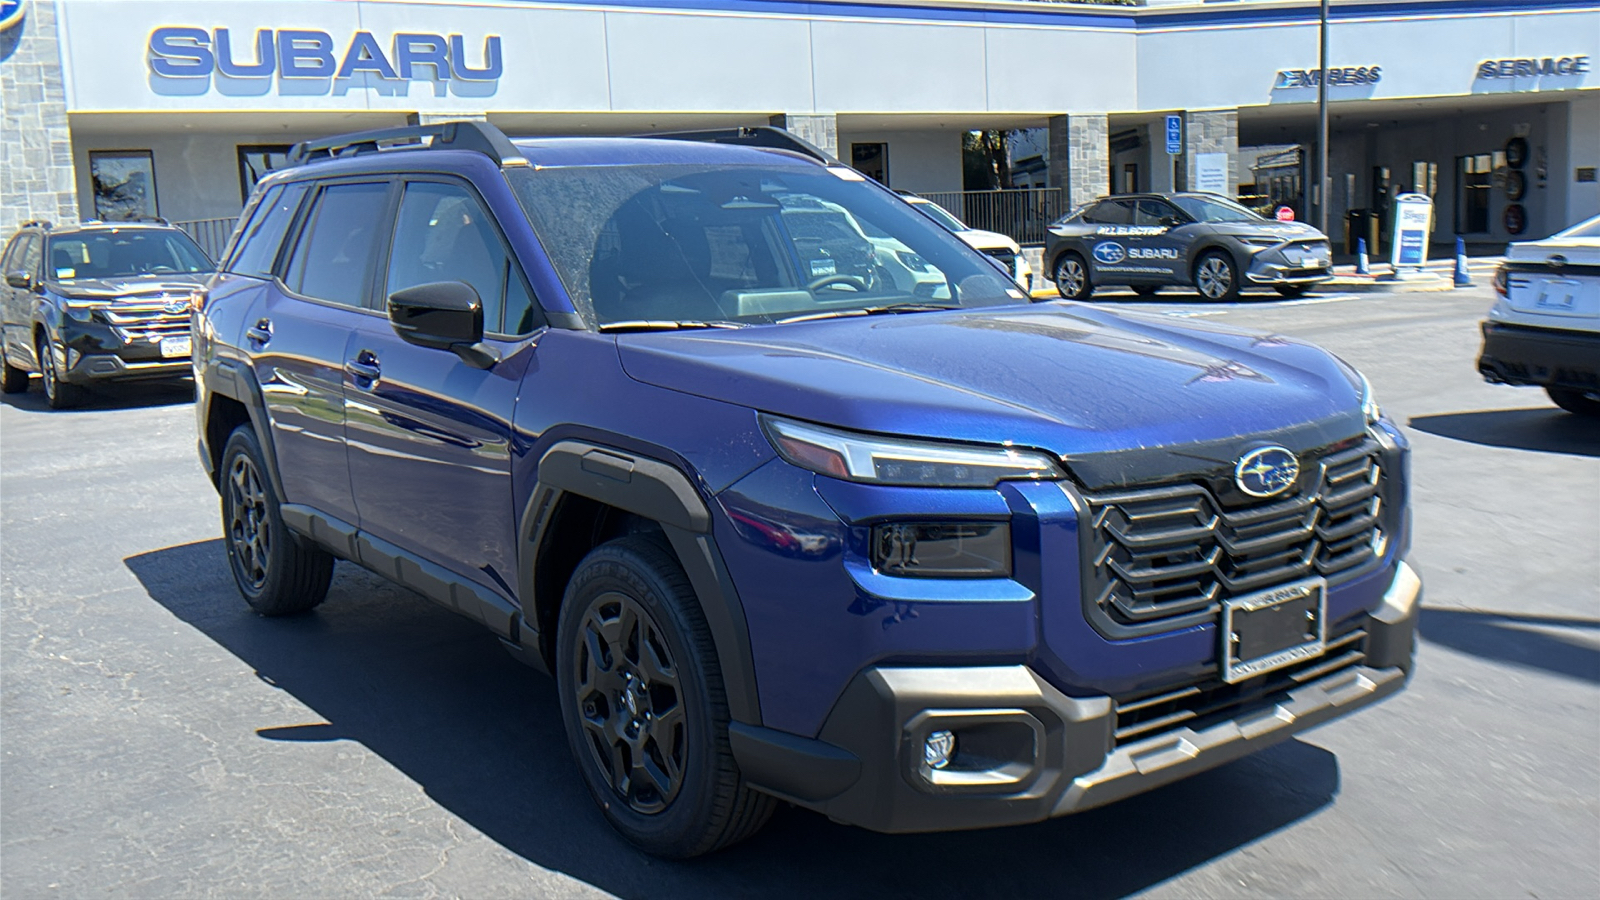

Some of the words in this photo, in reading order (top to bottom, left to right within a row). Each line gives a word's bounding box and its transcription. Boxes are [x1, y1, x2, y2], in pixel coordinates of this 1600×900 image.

[147, 27, 503, 82] SUBARU
[1477, 56, 1590, 79] SERVICE
[1097, 226, 1116, 235] ALL
[1117, 226, 1168, 235] ELECTRIC
[1128, 247, 1178, 259] SUBARU
